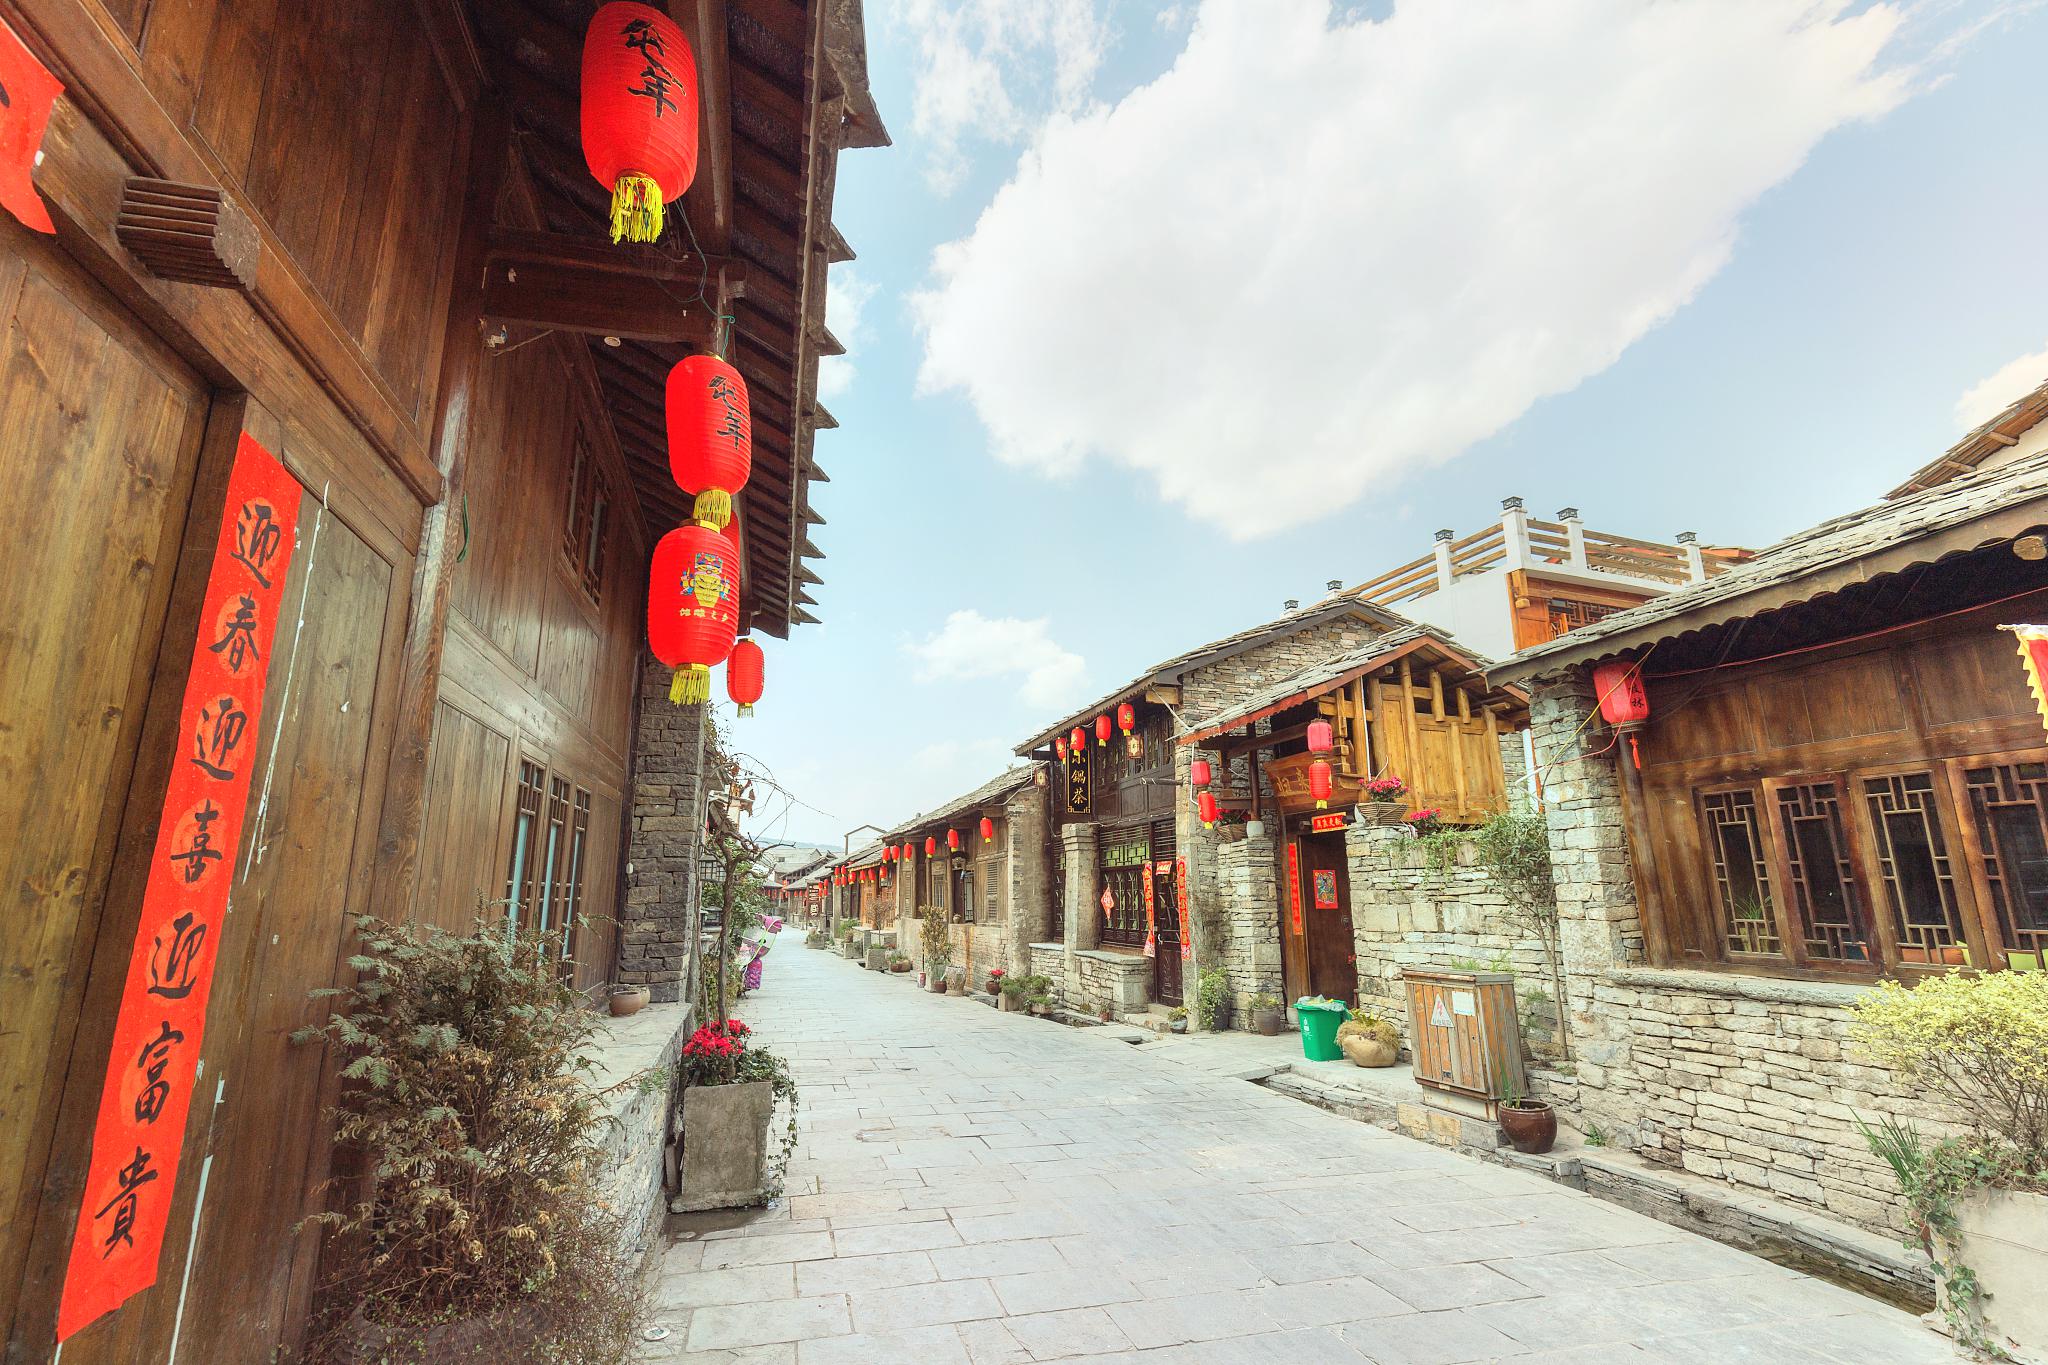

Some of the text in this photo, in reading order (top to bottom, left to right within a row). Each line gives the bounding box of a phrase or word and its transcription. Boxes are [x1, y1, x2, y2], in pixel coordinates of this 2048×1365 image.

[95, 502, 281, 1261] 迎春迎喜迎富貴
